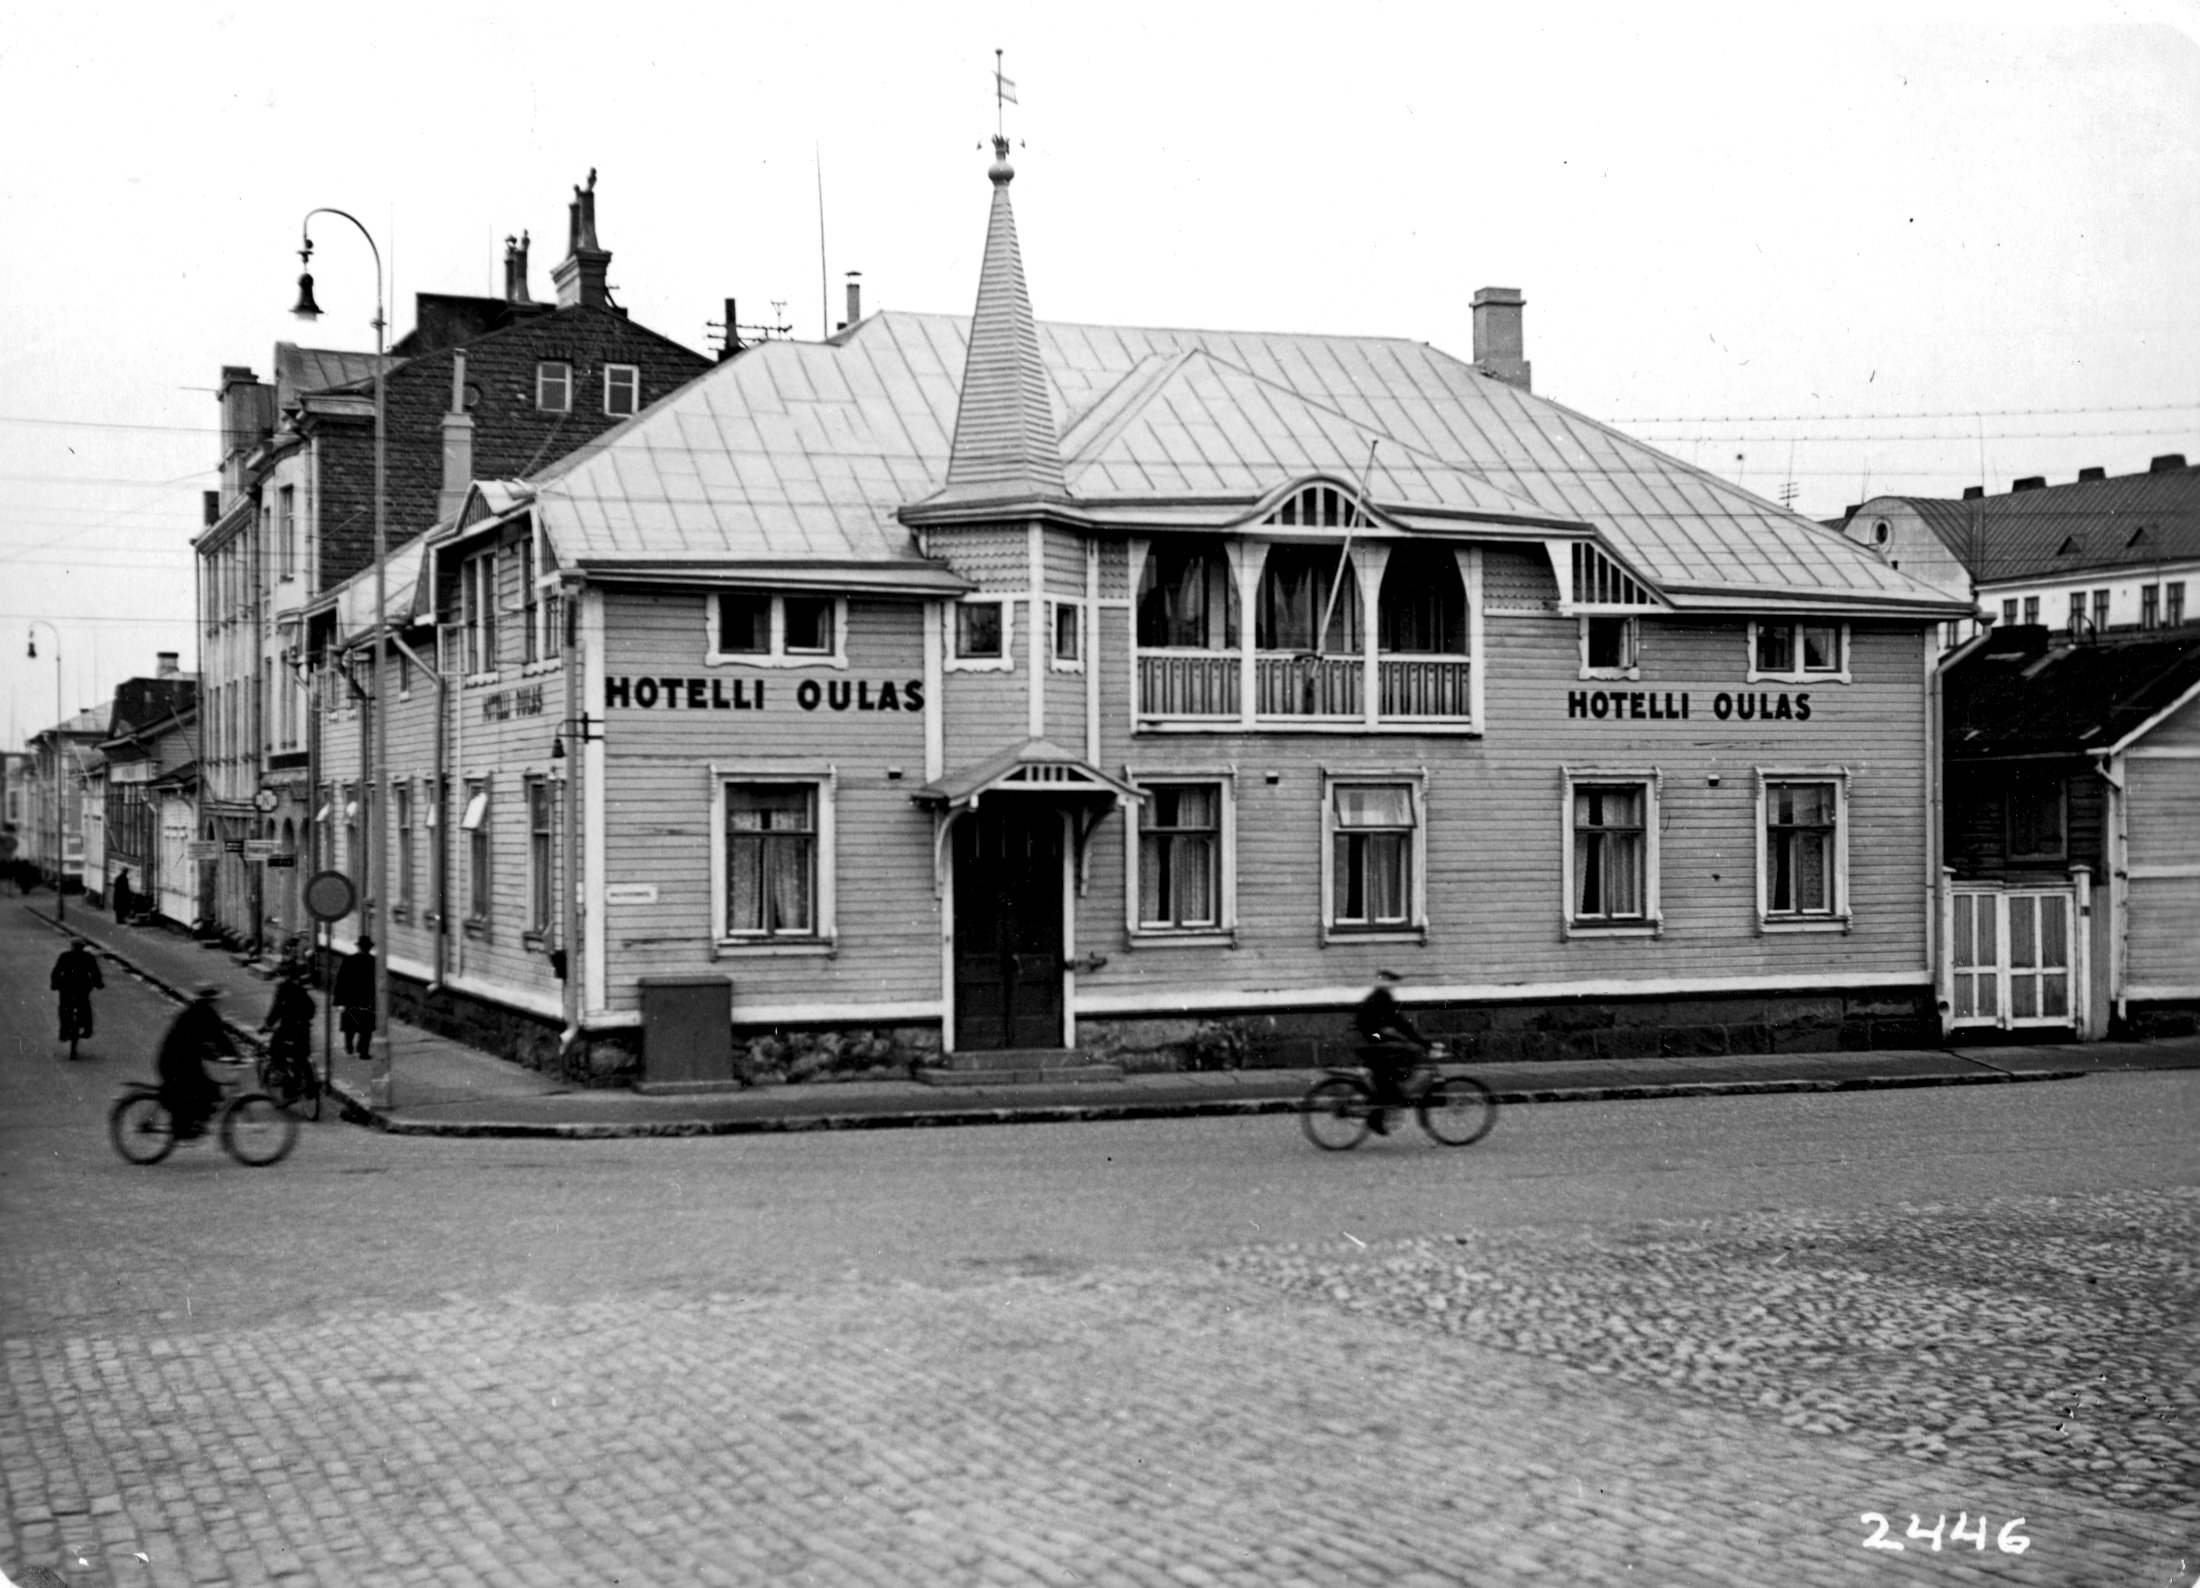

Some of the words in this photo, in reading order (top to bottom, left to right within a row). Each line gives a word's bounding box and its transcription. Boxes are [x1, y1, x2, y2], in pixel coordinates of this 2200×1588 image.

[605, 676, 765, 710] HOTELLI
[796, 679, 926, 712] OULAS
[1568, 691, 1689, 719] HOTELLI
[1713, 692, 1812, 721] OULAS
